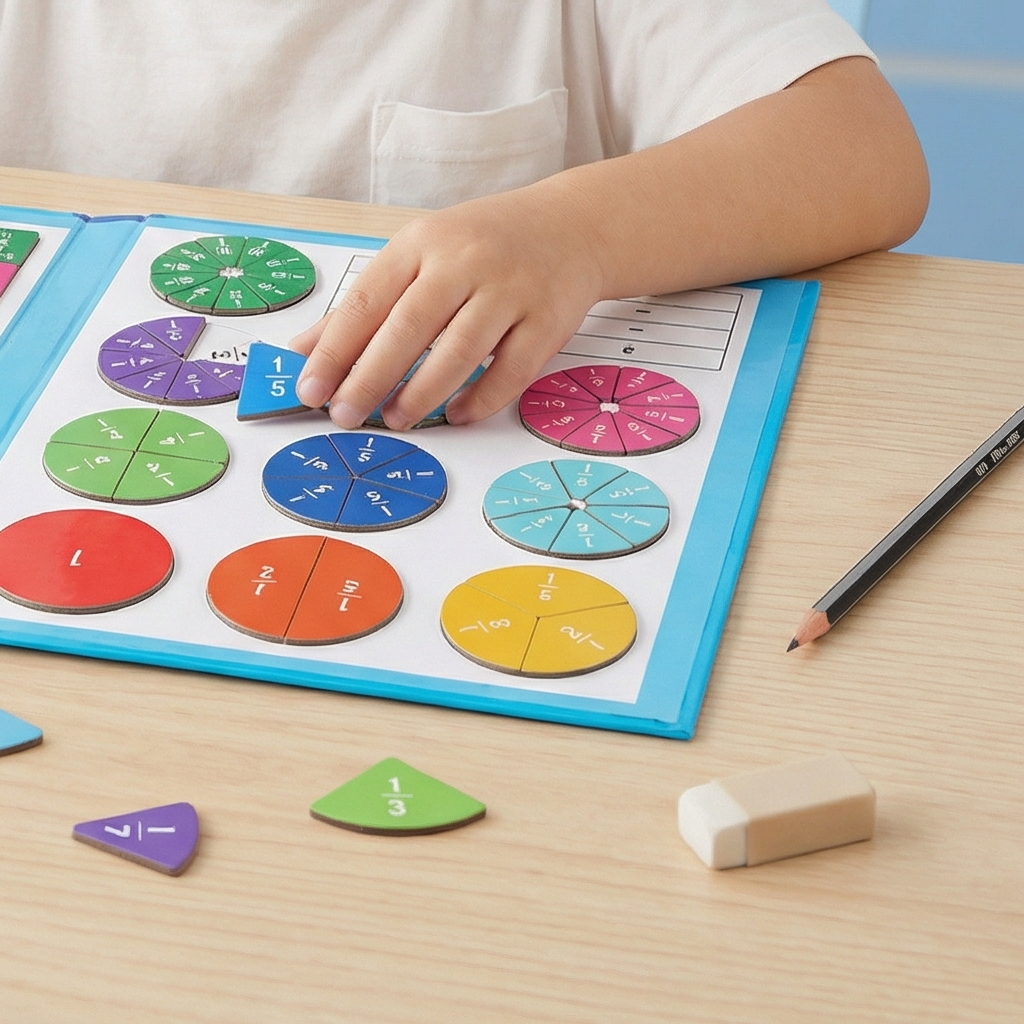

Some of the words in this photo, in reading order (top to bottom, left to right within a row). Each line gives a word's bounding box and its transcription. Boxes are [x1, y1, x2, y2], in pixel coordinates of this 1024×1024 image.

[271, 354, 283, 374] 1
[269, 380, 287, 398] 5
[387, 776, 401, 794] 1
[387, 798, 408, 818] 3
